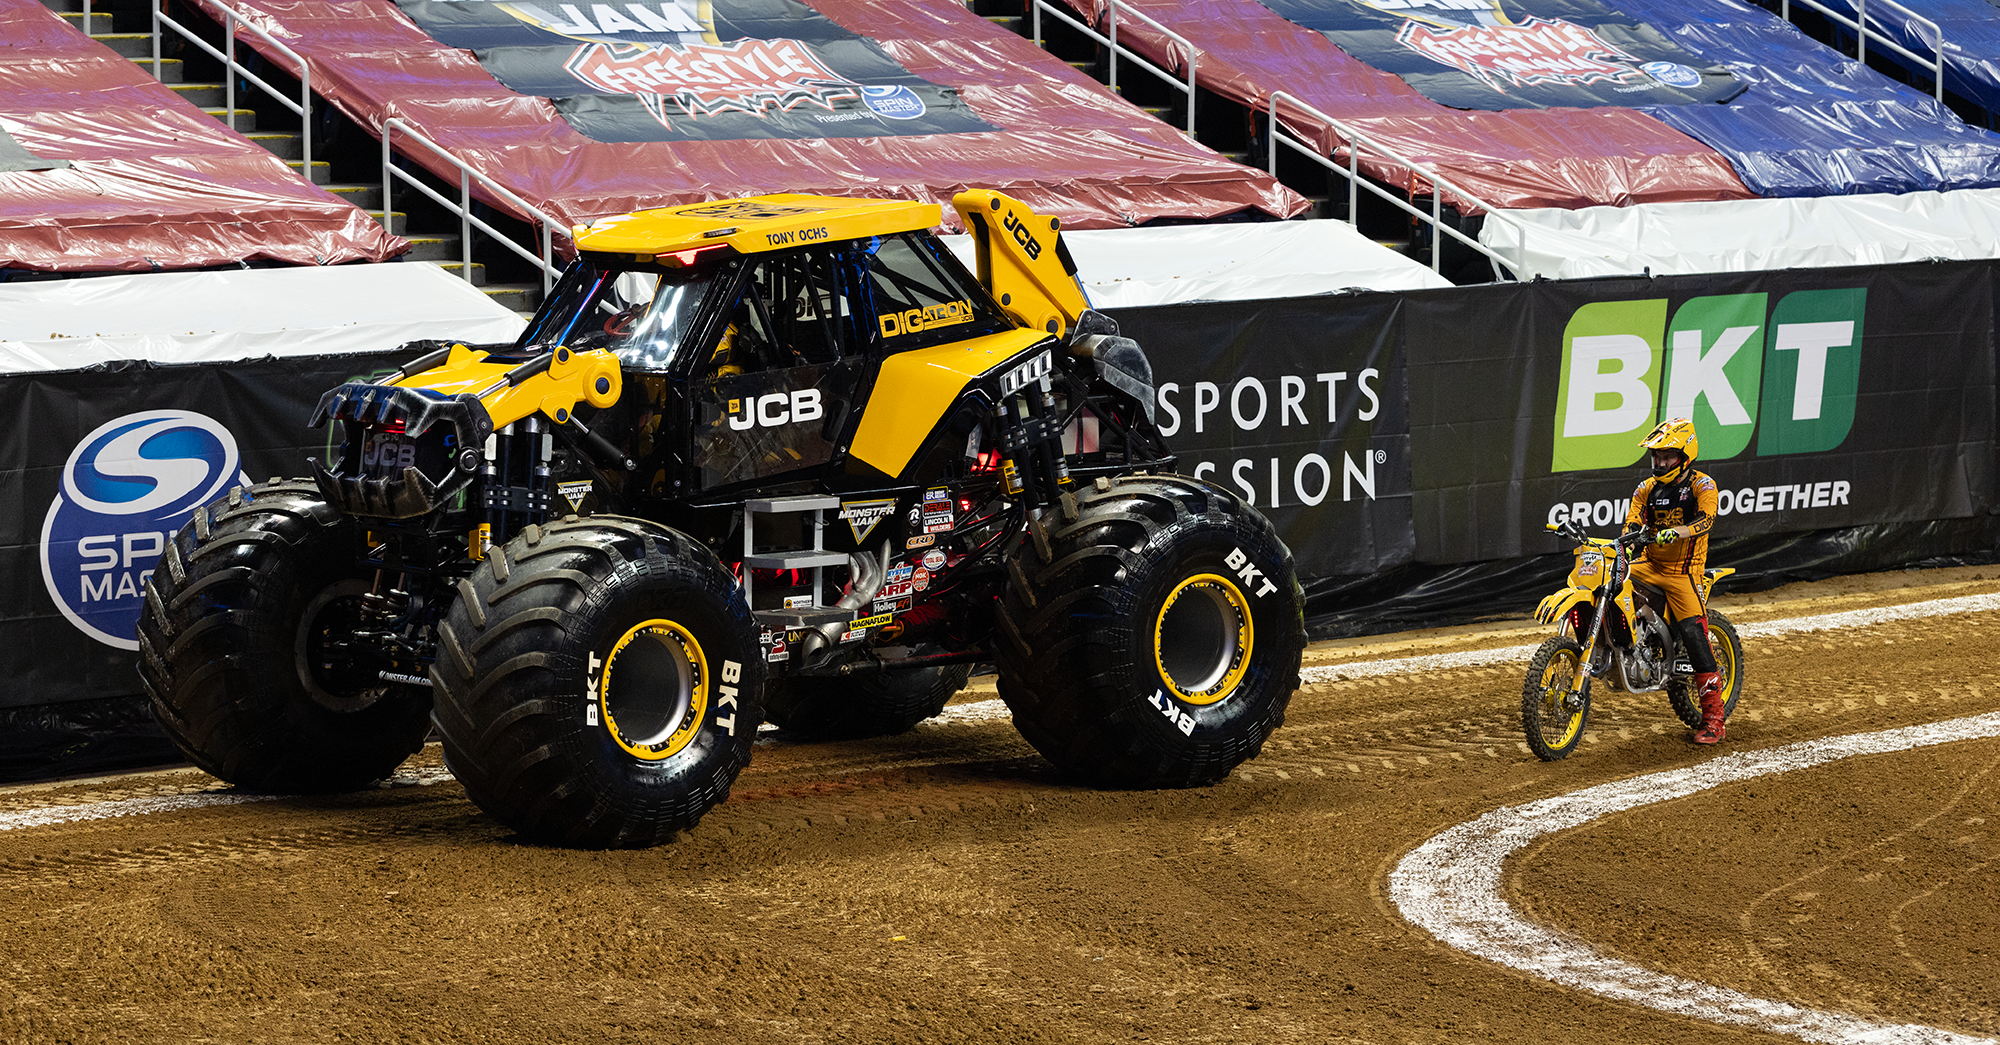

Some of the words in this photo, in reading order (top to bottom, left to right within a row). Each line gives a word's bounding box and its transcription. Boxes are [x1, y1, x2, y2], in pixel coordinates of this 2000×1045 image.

[551, 3, 706, 34] JAM
[1421, 25, 1597, 64] FREESTYLE
[593, 46, 819, 94] FREESTYLE
[874, 97, 914, 108] SPIN
[880, 103, 920, 114] MASTER
[814, 111, 861, 123] Presented
[860, 110, 876, 120] by
[766, 231, 795, 246] TONY
[798, 227, 828, 241] OCHS
[1002, 209, 1042, 261] JCB
[1563, 320, 1855, 438] BKT
[728, 389, 823, 431] JCB
[1157, 368, 1380, 438] SPORTS
[364, 442, 417, 468] JCB
[558, 486, 593, 494] MONSTER
[568, 492, 583, 500] JAM
[839, 506, 896, 519] MONSTER
[924, 501, 950, 513] DERALE
[1548, 498, 1631, 528] GROW
[1717, 480, 1851, 516] OGETHER
[852, 515, 880, 527] JAM
[924, 517, 948, 526] LINCOLN
[78, 530, 179, 571] SP
[80, 569, 155, 602] MAS
[1223, 547, 1278, 598] BKT
[875, 582, 912, 598] ARP
[874, 601, 897, 613] Holley
[851, 614, 891, 629] MAGNAFLOW
[1676, 663, 1694, 672] JCB
[586, 651, 601, 727] BKT
[715, 659, 742, 737] BKT
[1148, 688, 1197, 737] BKT
